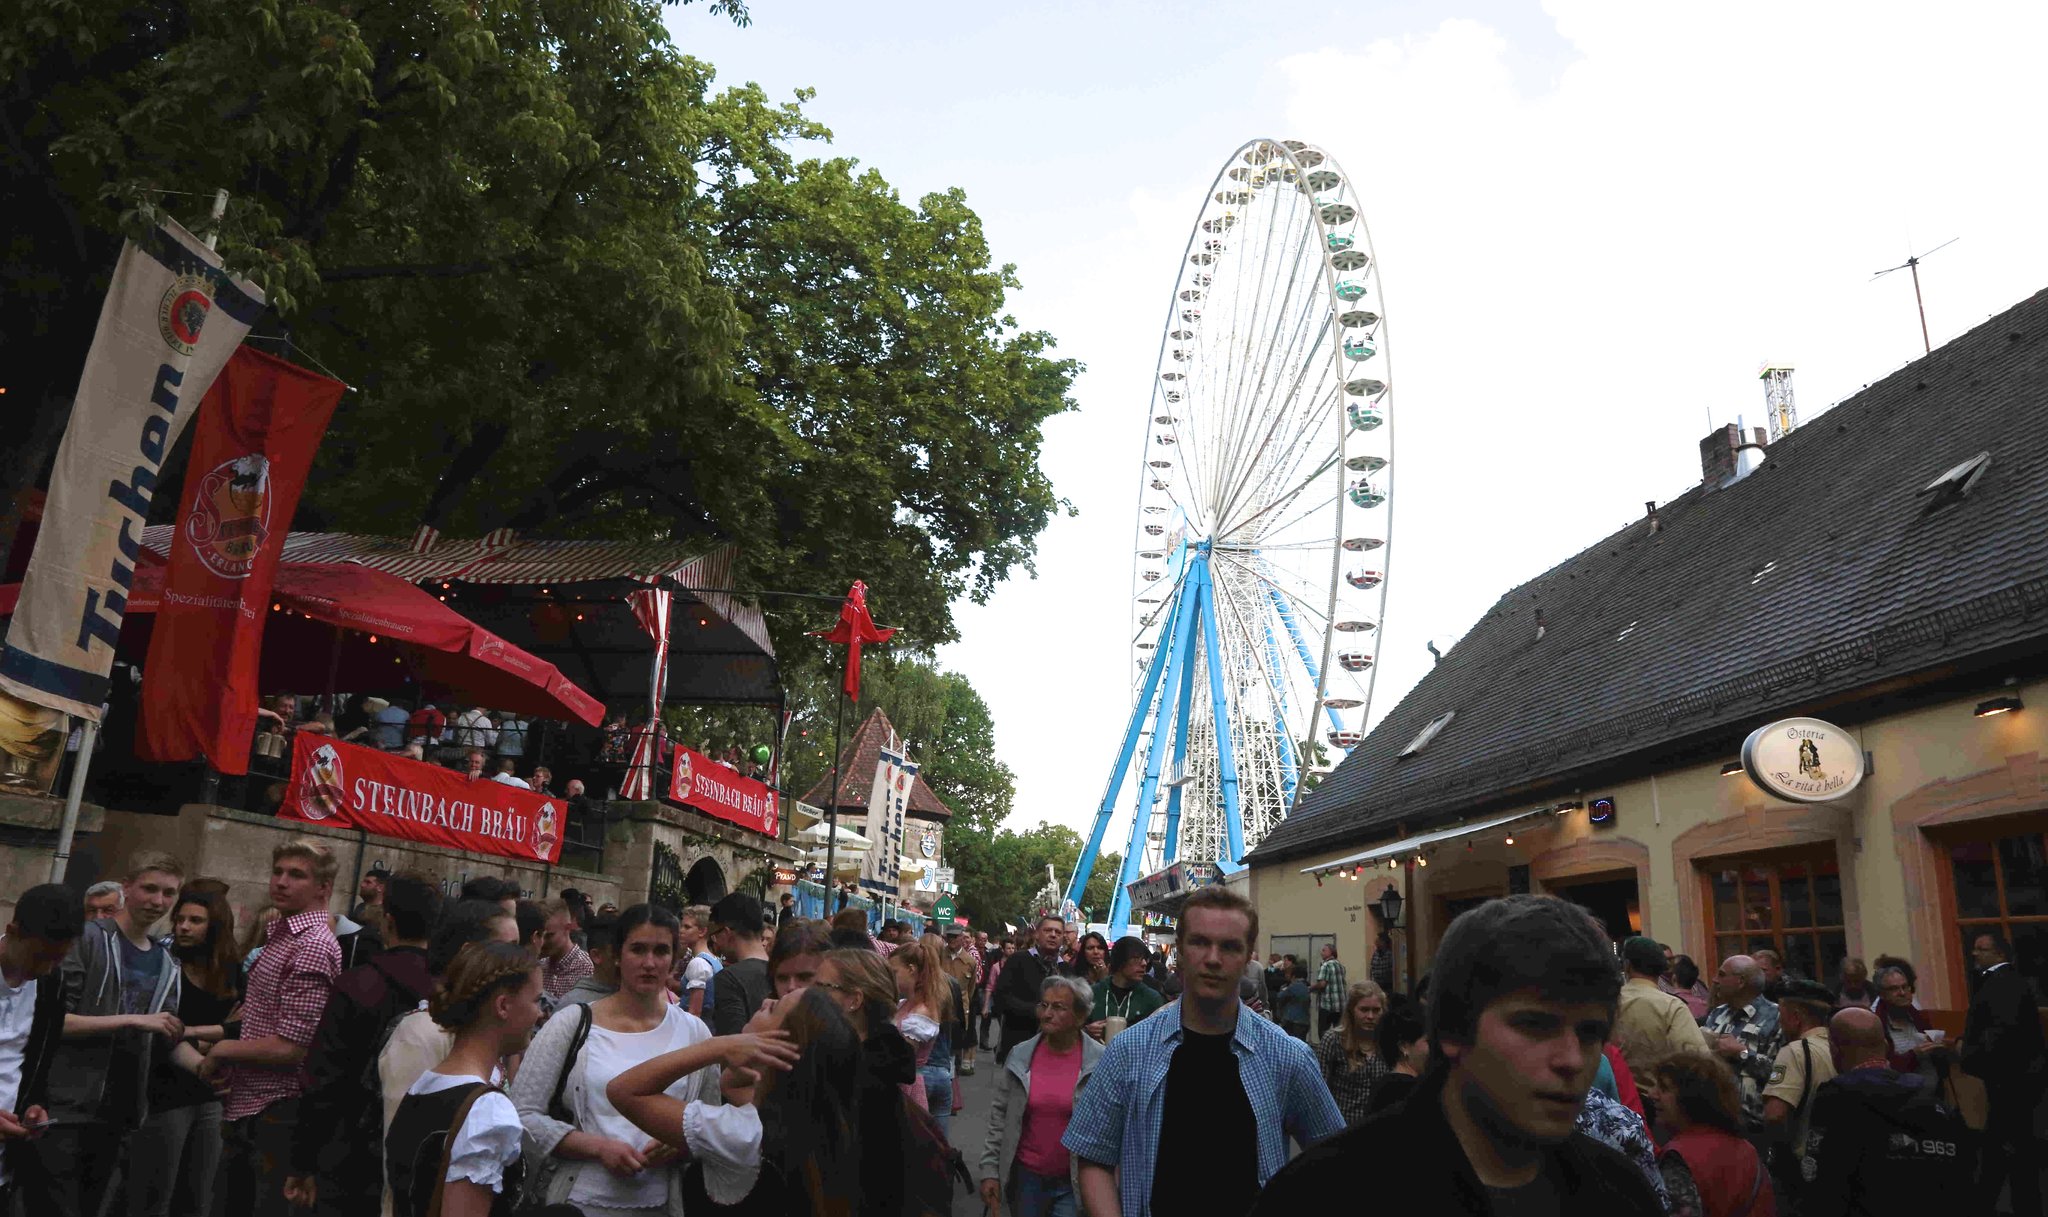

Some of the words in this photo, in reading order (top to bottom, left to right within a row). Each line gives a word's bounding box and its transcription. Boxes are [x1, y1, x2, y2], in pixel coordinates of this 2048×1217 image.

[1786, 727, 1826, 741] Osteria
[353, 777, 475, 833] STEINBACH
[479, 807, 528, 843] BRÄU
[694, 772, 741, 810] STEINBACH
[742, 793, 764, 818] BRÄU
[937, 906, 951, 916] WC
